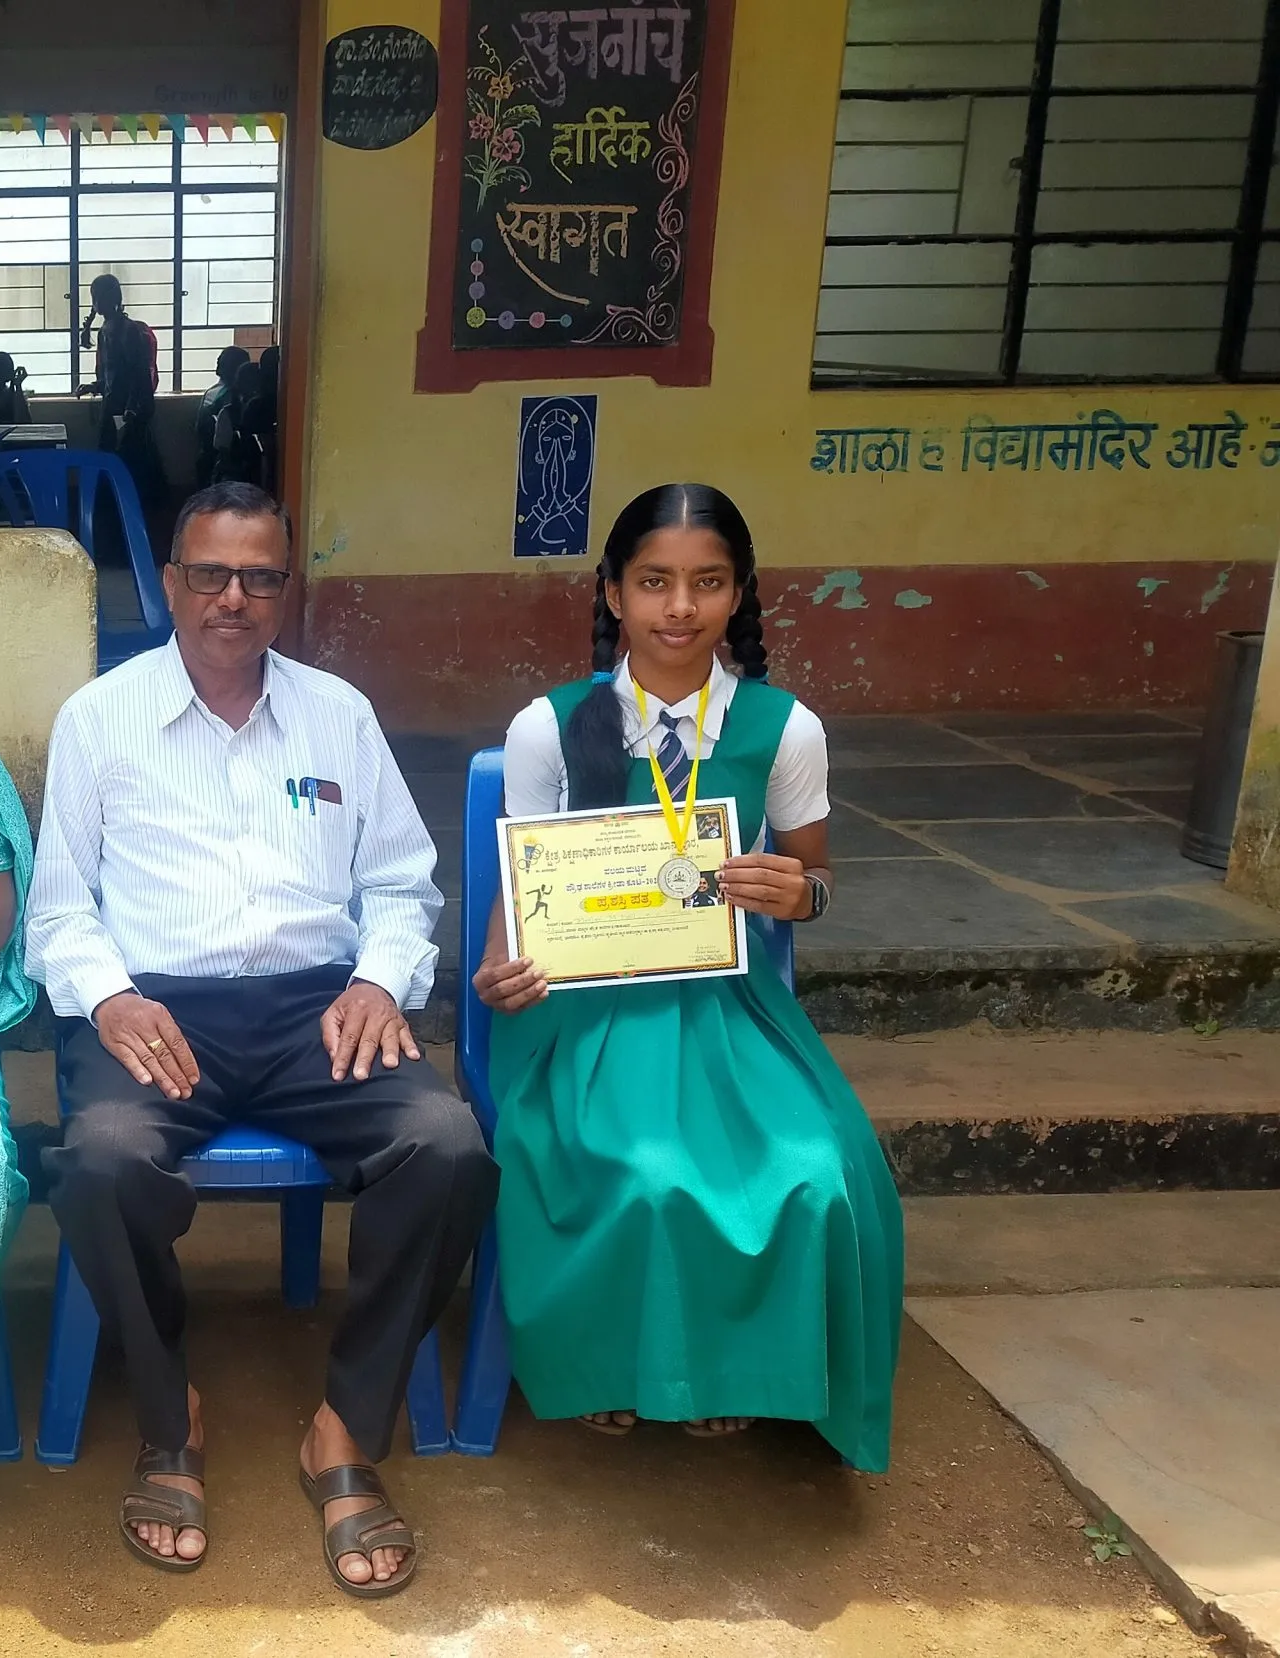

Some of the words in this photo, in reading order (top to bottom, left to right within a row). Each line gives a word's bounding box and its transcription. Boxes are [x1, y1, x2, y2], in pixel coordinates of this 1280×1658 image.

[550, 105, 652, 184] हार्दिक
[496, 202, 638, 305] स्वागत
[809, 428, 911, 475] शाळा
